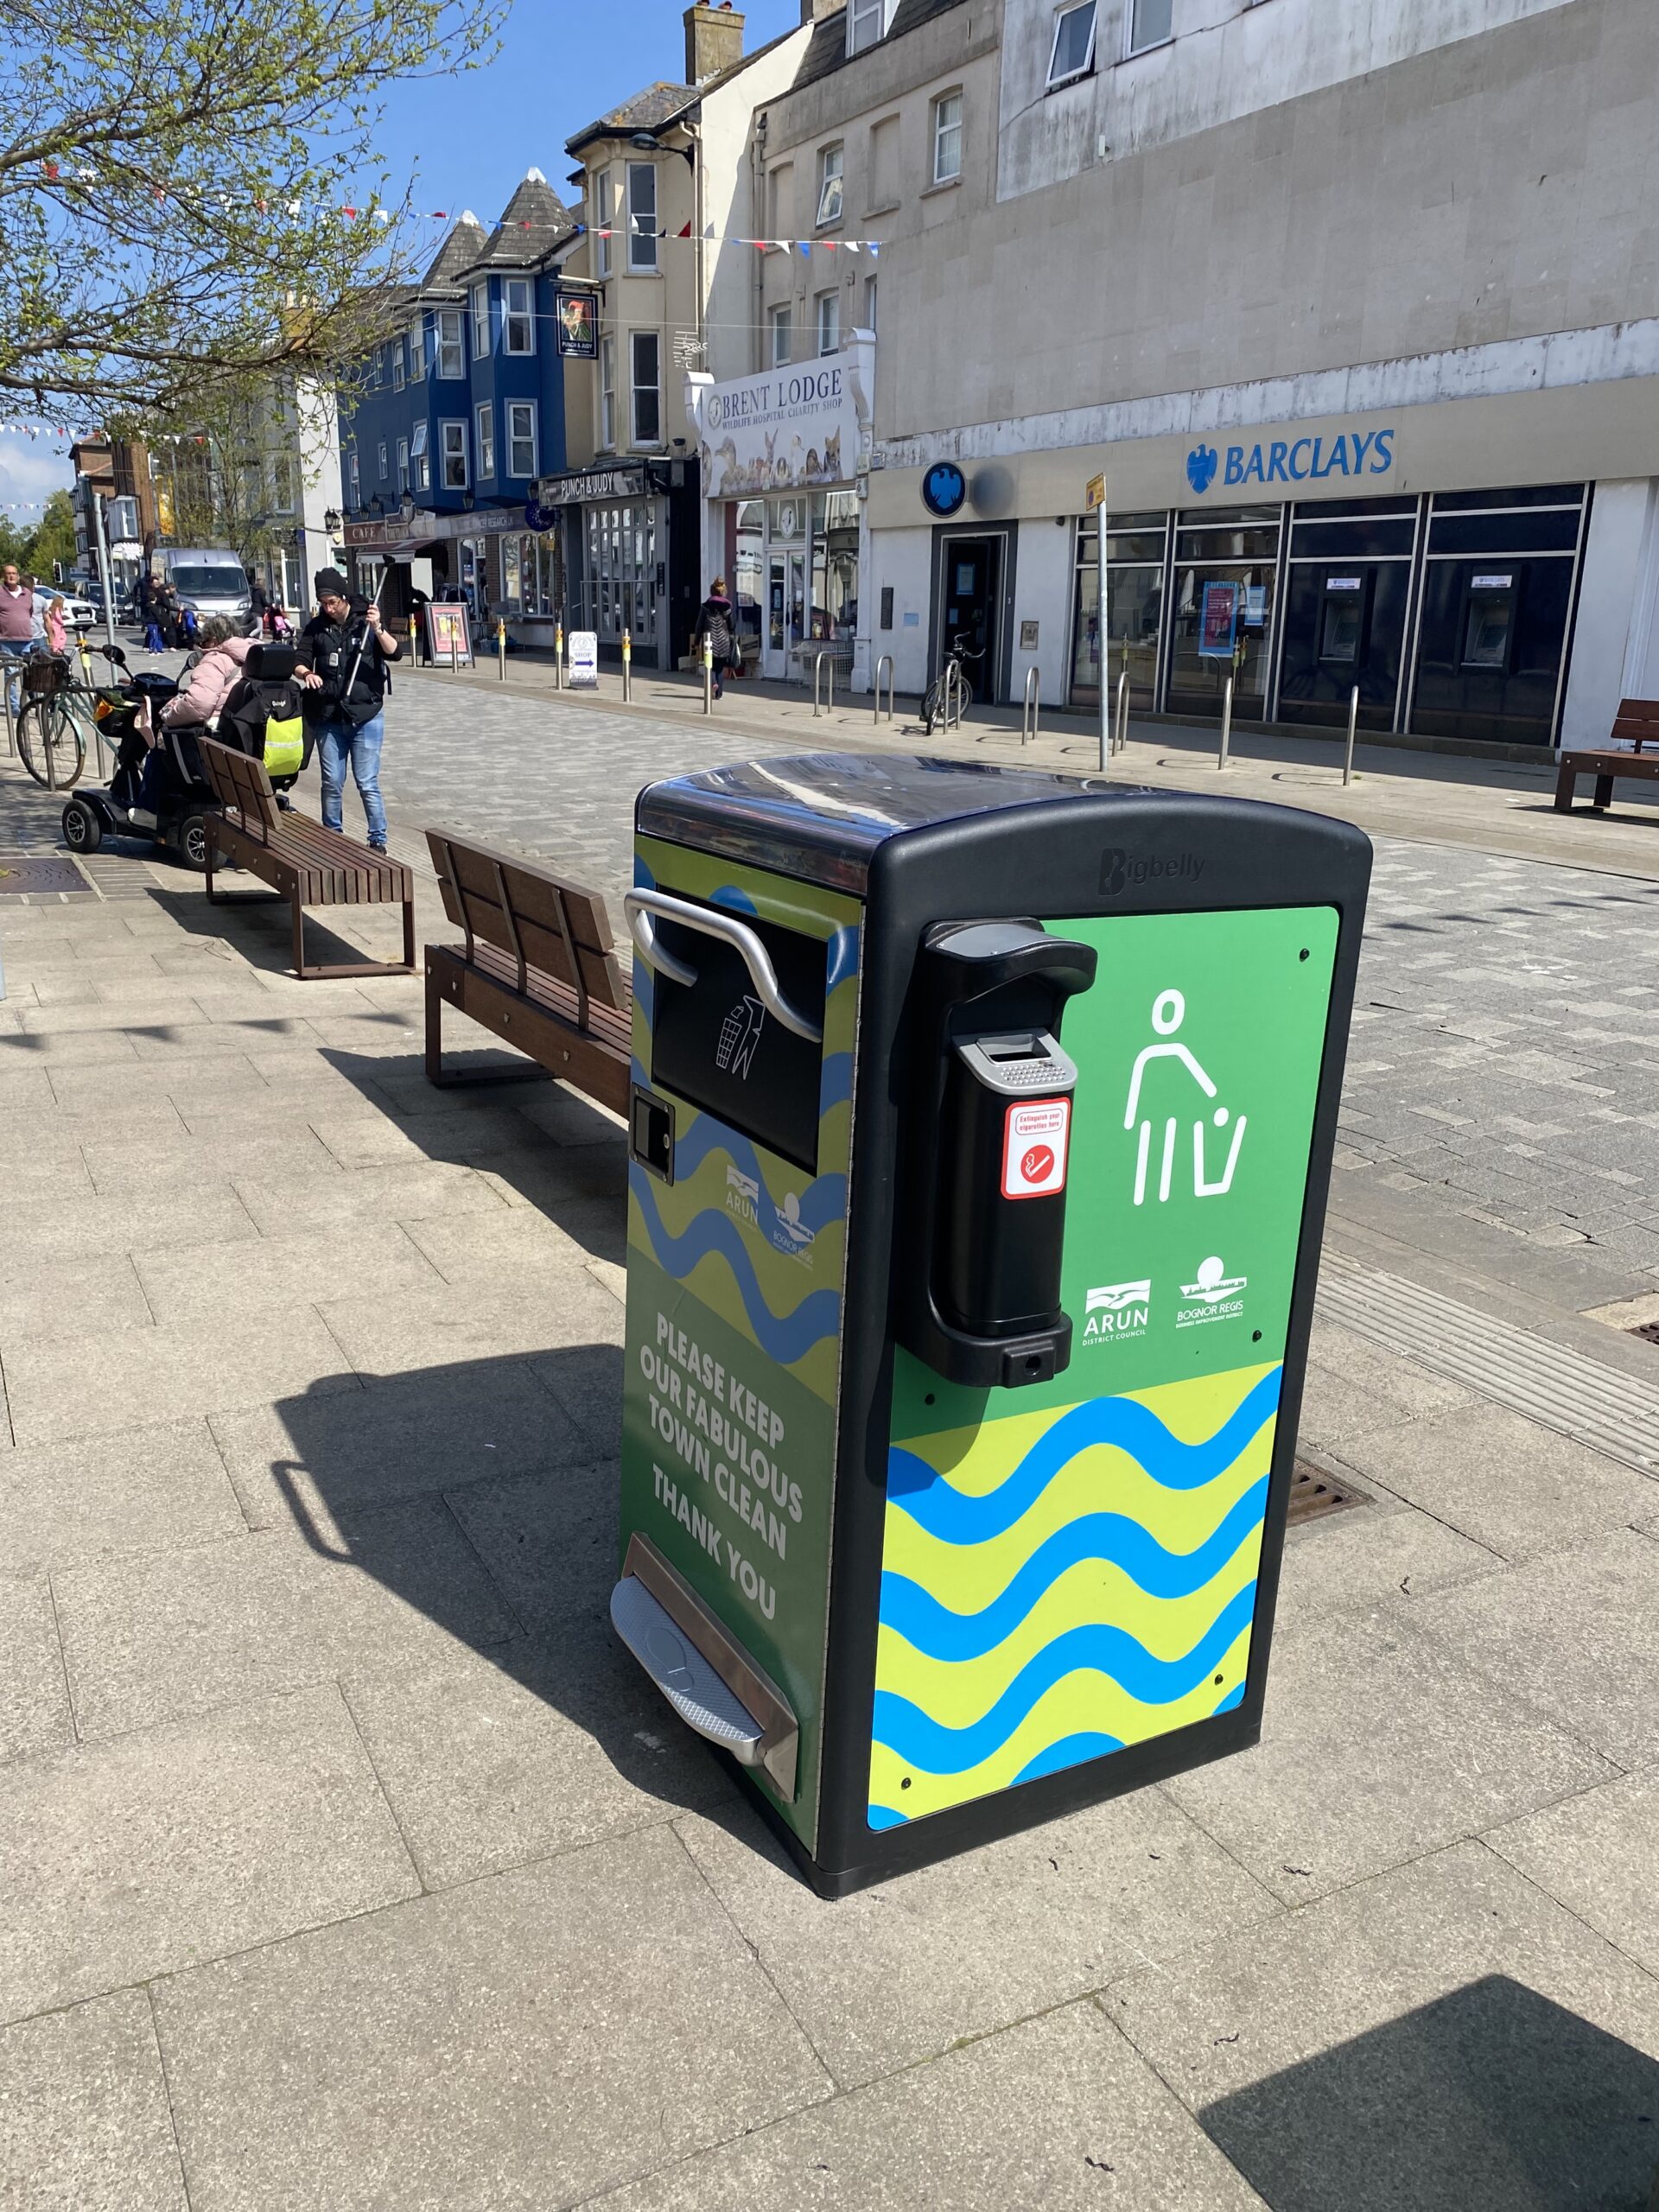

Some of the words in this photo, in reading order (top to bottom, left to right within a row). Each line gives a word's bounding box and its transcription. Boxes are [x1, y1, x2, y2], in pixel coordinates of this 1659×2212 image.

[722, 385, 770, 419] BRENT
[779, 369, 842, 407] LODGE
[722, 417, 752, 430] WILDLIFE
[753, 410, 785, 426] HOSPITAL
[787, 403, 820, 418] CHARITY
[823, 397, 842, 411] SHOP
[1224, 429, 1395, 486] BARCLAYS
[561, 476, 585, 498] PUNCH
[587, 475, 592, 494] &
[594, 472, 613, 493] JUDY
[1098, 848, 1206, 896] Bigbelly
[1020, 1122, 1047, 1132] cigarettes
[727, 1192, 758, 1225] ARUN
[773, 1230, 798, 1253] BOGNOR
[1083, 1307, 1148, 1337] ARUN
[1177, 1305, 1217, 1322] BOGNOR
[1219, 1300, 1244, 1313] REGIS
[1082, 1333, 1115, 1346] DISTRICT
[1116, 1329, 1147, 1340] COUNCIL
[658, 1312, 725, 1402] PLEASE
[729, 1376, 785, 1451] KEEP
[640, 1344, 681, 1410] OUR
[686, 1383, 803, 1523] FABULOUS
[649, 1393, 710, 1483] TOWN
[715, 1462, 786, 1560] CLEAN
[653, 1462, 722, 1567] THANK
[727, 1540, 776, 1620] YOU
